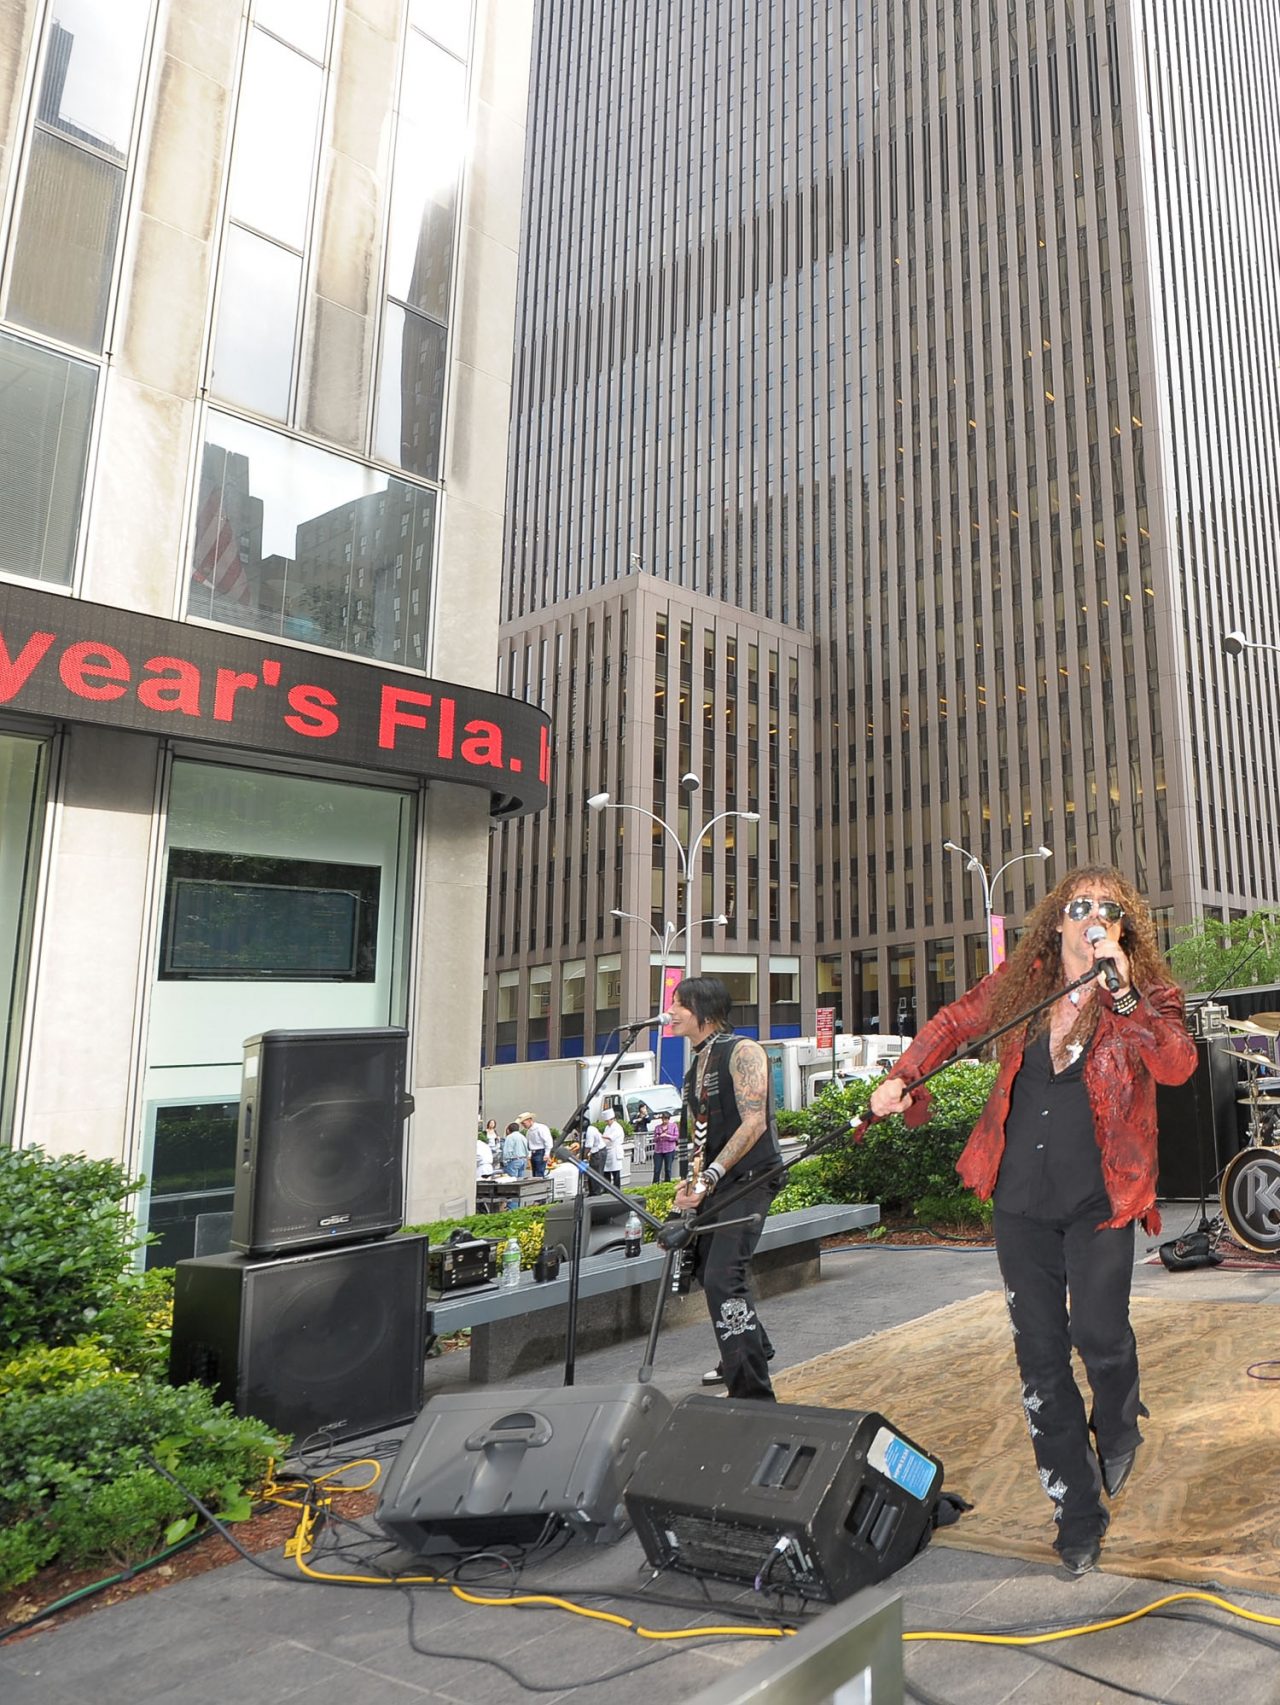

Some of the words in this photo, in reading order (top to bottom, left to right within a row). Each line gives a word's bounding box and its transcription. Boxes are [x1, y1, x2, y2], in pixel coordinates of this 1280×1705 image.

[0, 631, 339, 739] year's
[378, 685, 522, 772] Fla.
[319, 1215, 350, 1226] QSC
